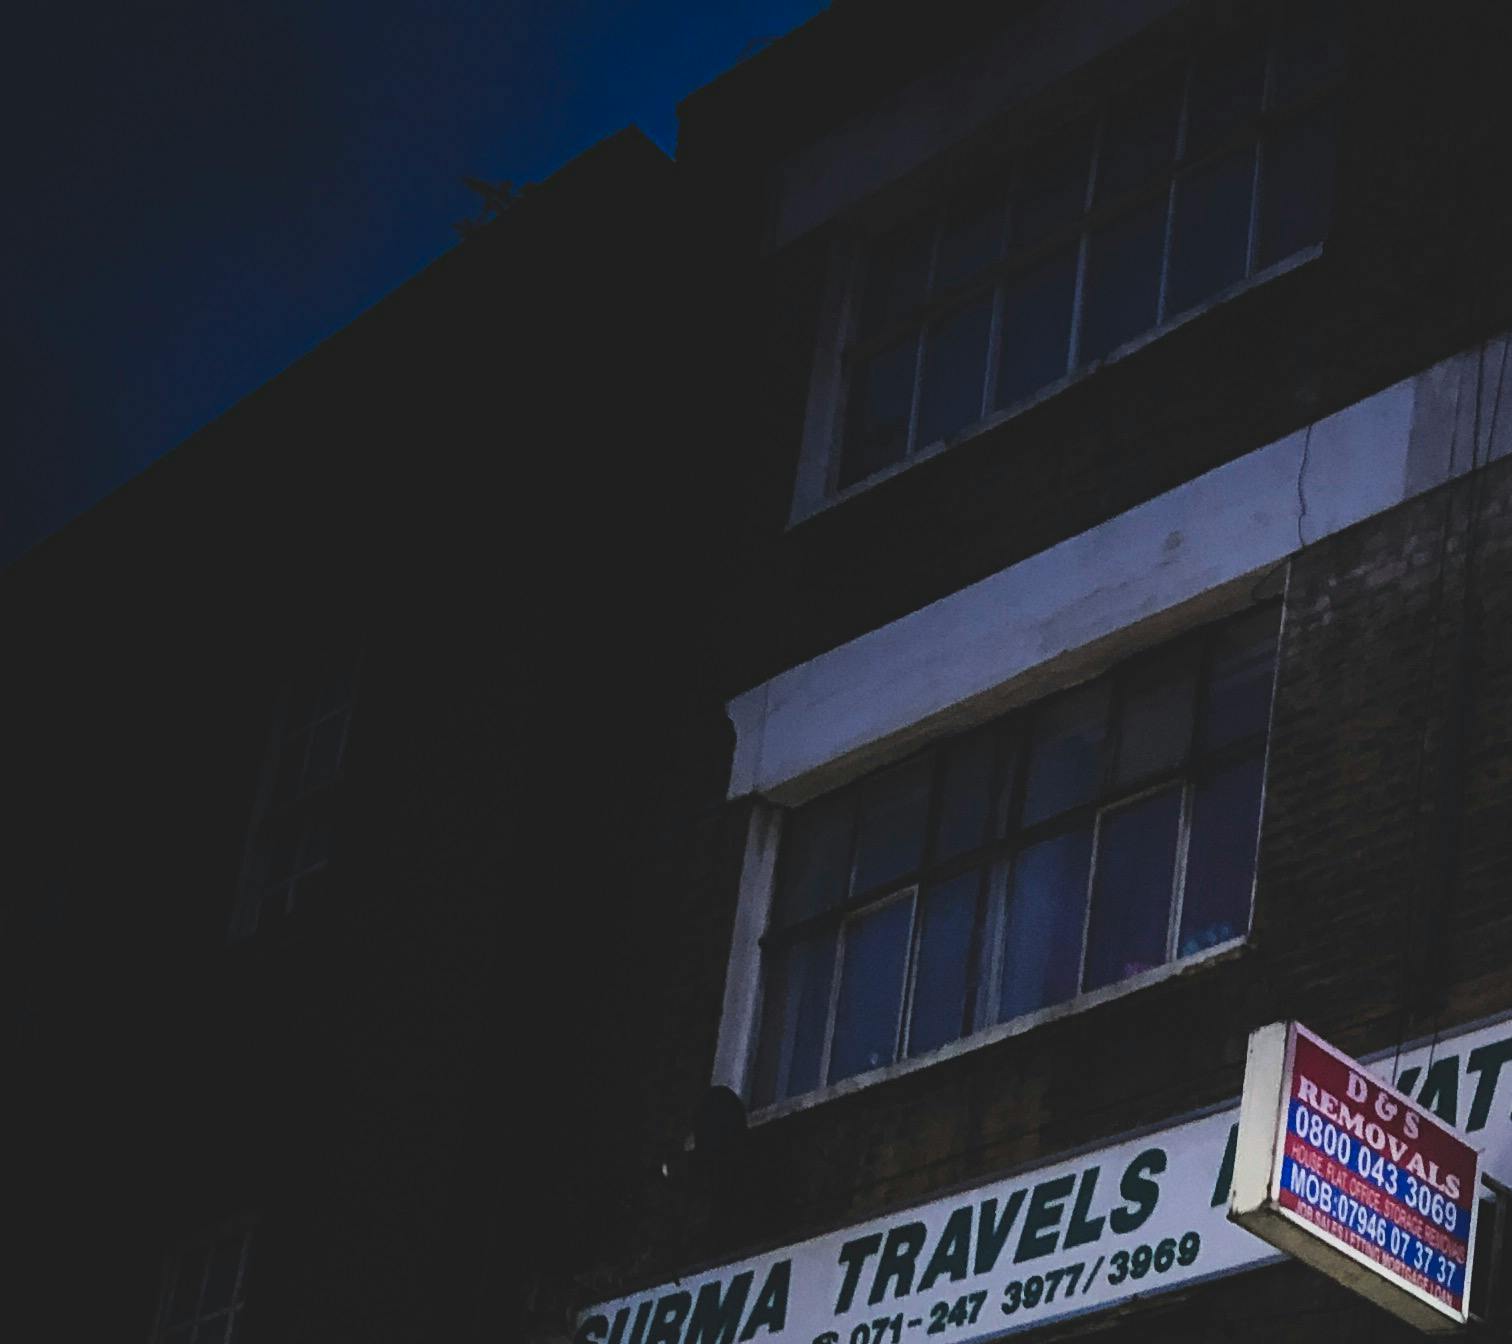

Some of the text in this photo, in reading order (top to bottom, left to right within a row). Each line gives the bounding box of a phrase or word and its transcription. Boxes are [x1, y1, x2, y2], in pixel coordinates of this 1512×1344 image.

[1298, 1075, 1461, 1199] REMOVALS
[1346, 1070, 1420, 1139] D & S
[834, 1148, 1168, 1315] TRAVELS
[1289, 1162, 1457, 1288] MOB:07946 07 37 37
[1295, 1106, 1457, 1232] 0800 043 3069
[1000, 1231, 1201, 1317] 3977/3969
